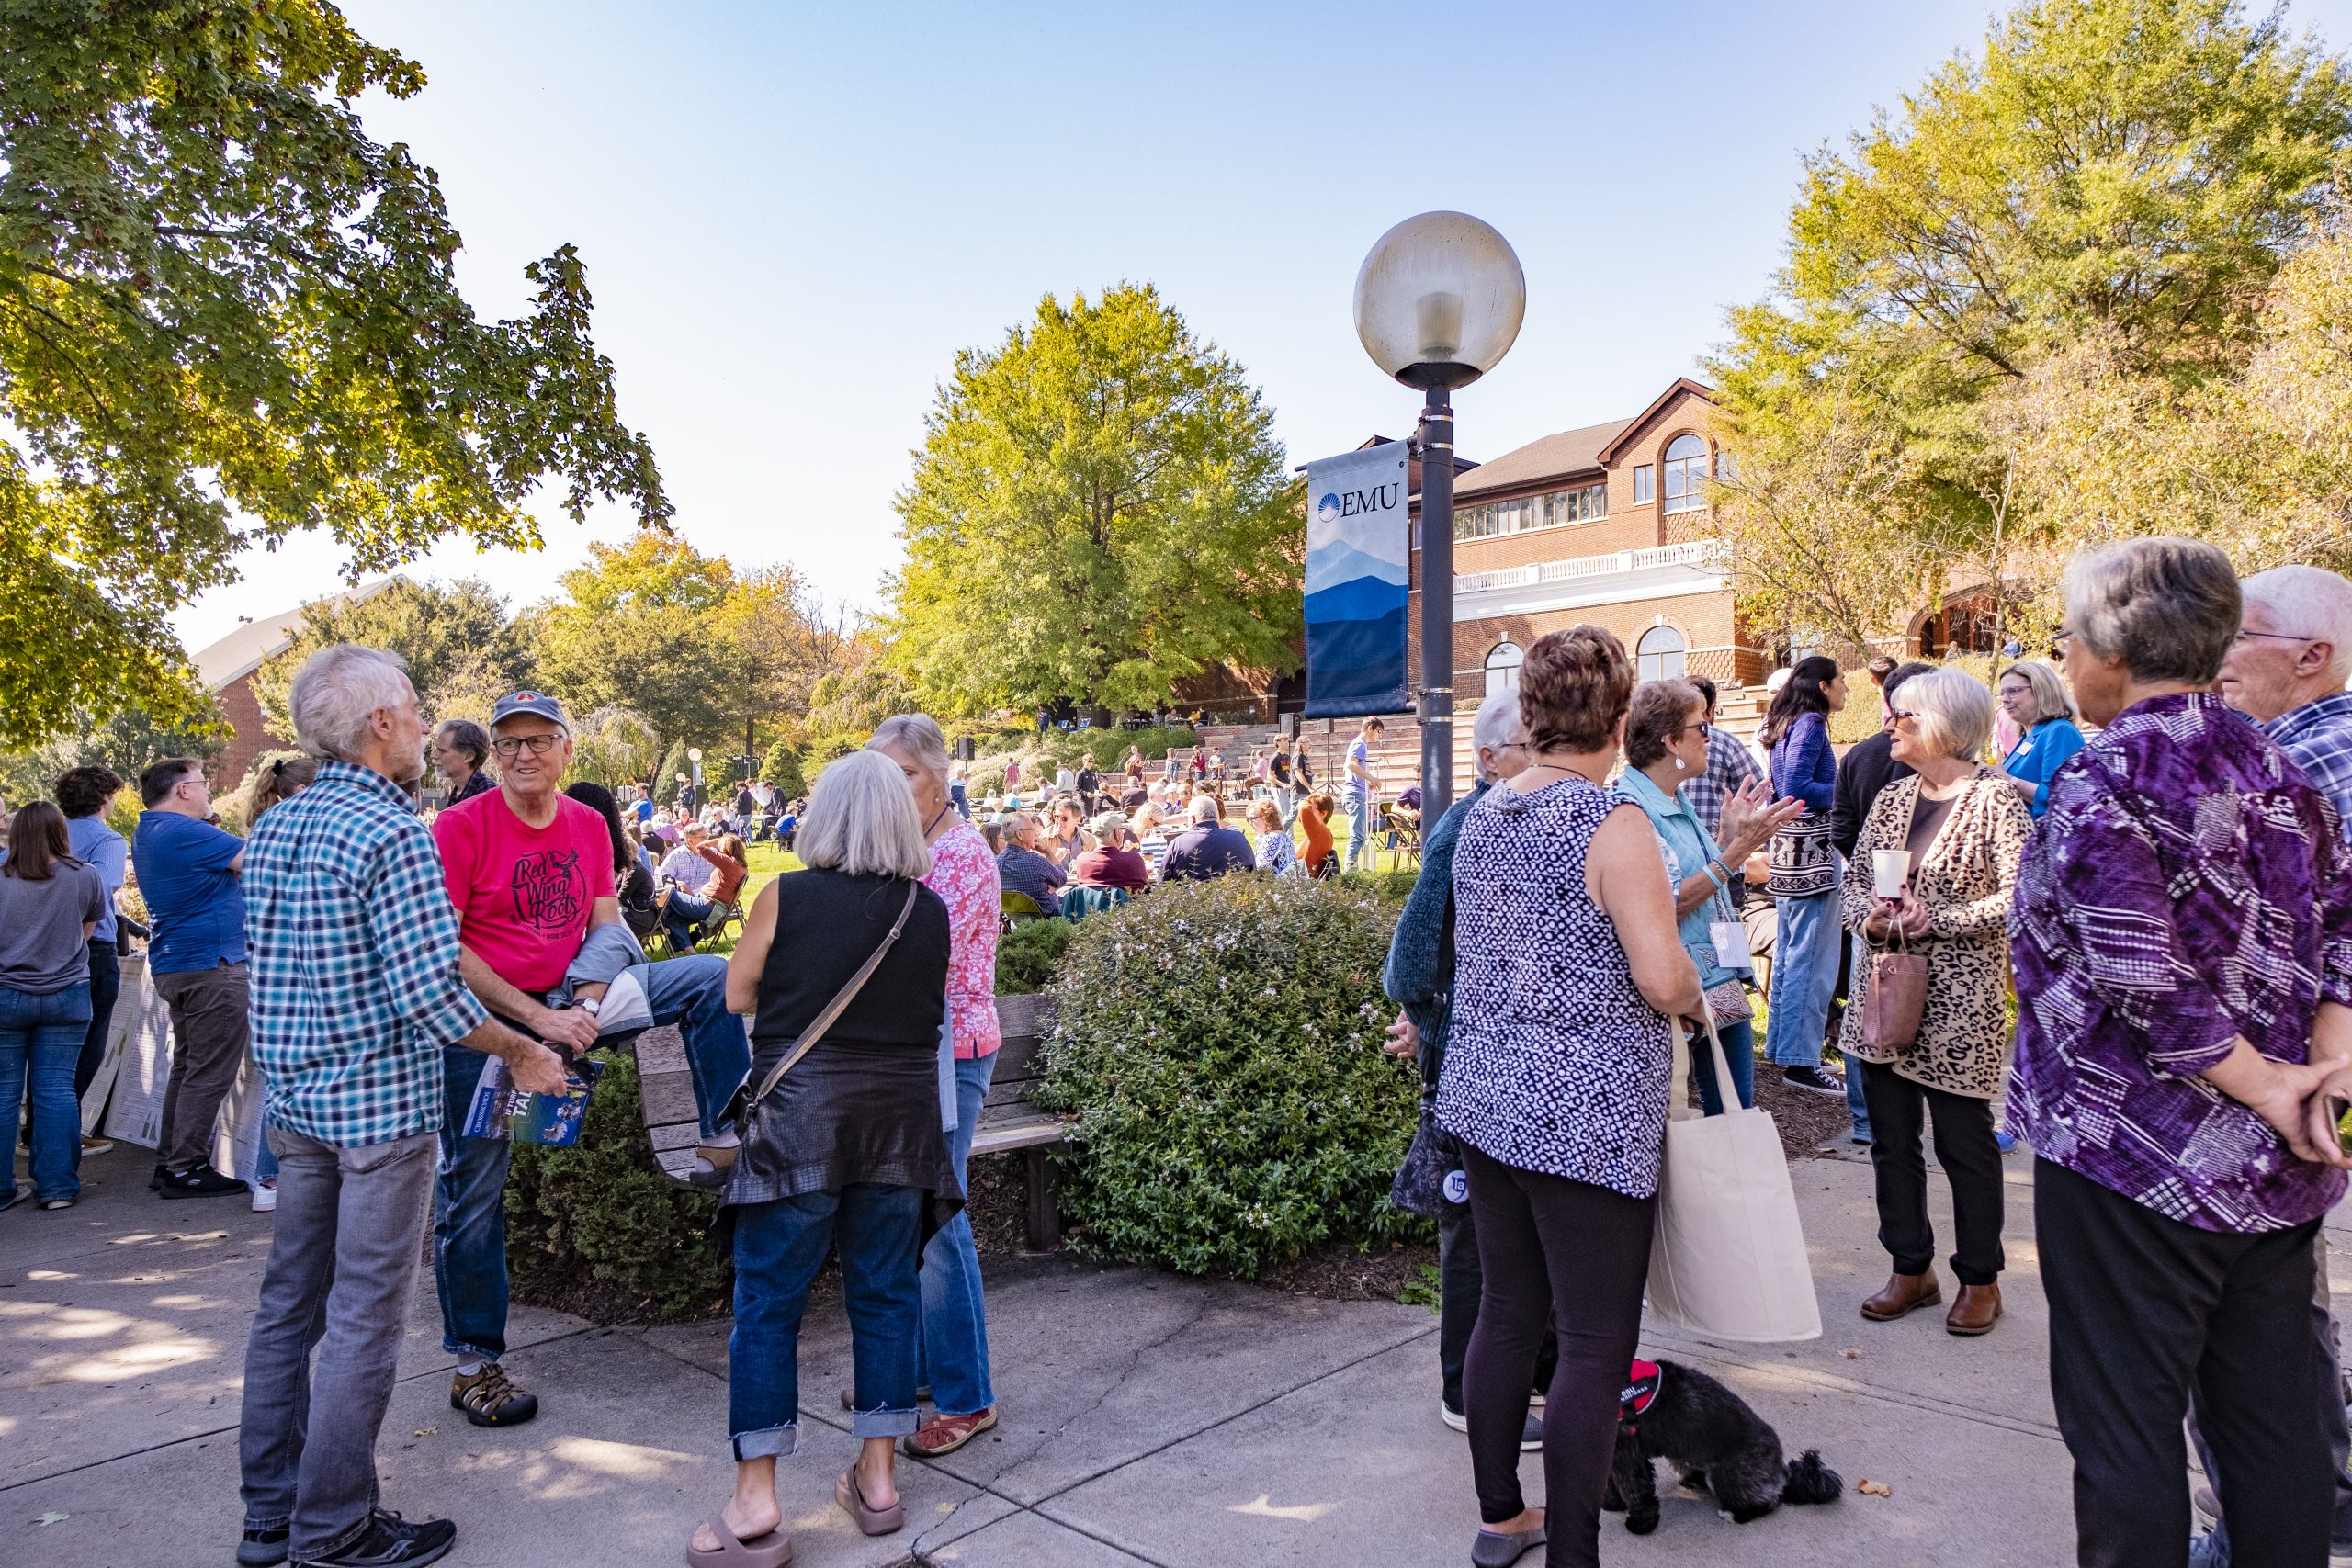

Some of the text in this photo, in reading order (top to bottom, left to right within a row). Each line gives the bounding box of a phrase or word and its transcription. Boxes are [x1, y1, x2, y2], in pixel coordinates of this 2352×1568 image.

[1340, 483, 1399, 518] EMU
[516, 854, 547, 882] Red
[521, 877, 568, 905] Wing
[529, 894, 579, 928] Roots
[474, 1091, 491, 1133] CROSSROADS
[504, 1089, 517, 1116] IF TURF
[512, 1091, 533, 1116] TAL
